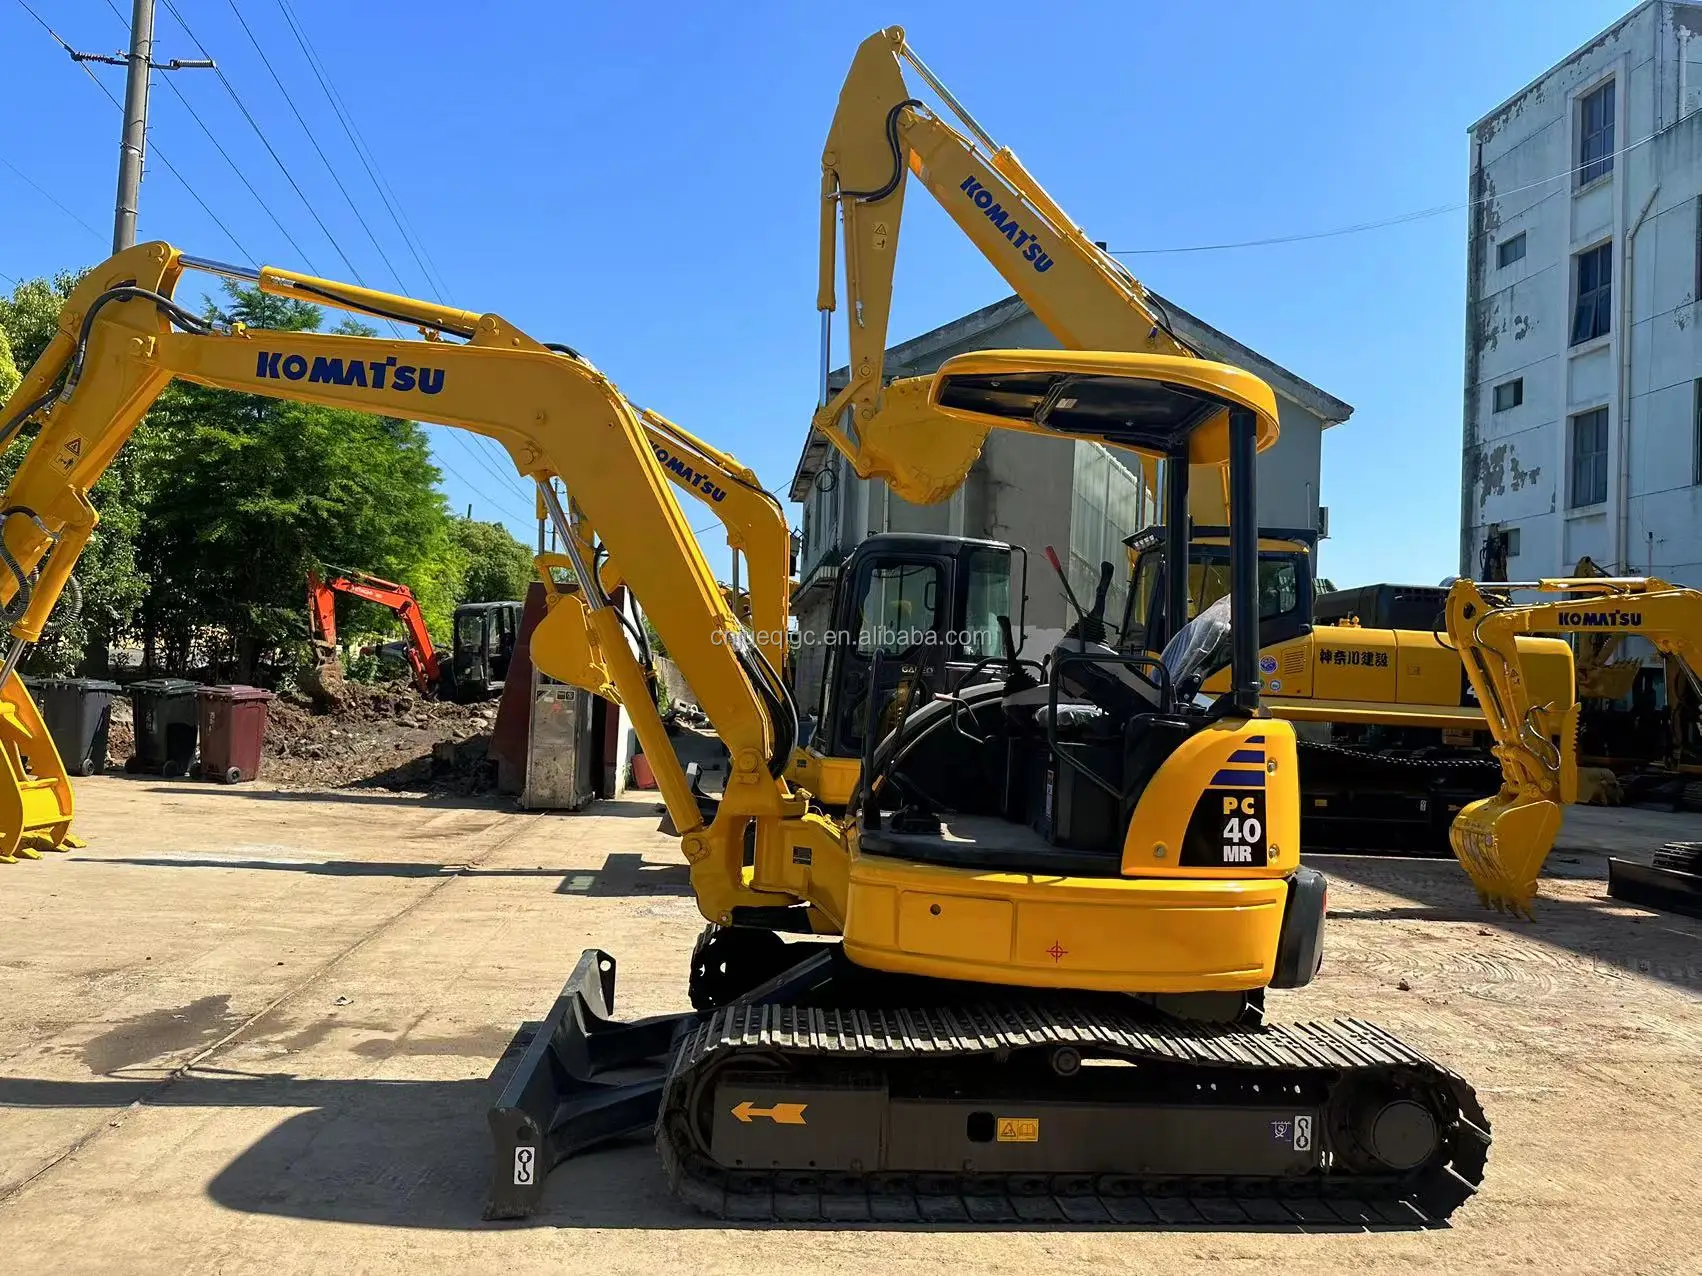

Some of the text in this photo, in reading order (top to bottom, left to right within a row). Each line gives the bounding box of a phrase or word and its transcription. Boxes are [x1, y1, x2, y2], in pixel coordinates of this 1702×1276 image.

[960, 175, 1054, 273] KOMATSU
[256, 351, 446, 395] KOMATSU
[1558, 609, 1642, 626] KOMATSU
[1319, 648, 1389, 668] 神奈川建設
[1223, 796, 1255, 815] PC
[1223, 817, 1262, 843] 40
[1223, 845, 1252, 862] MR
